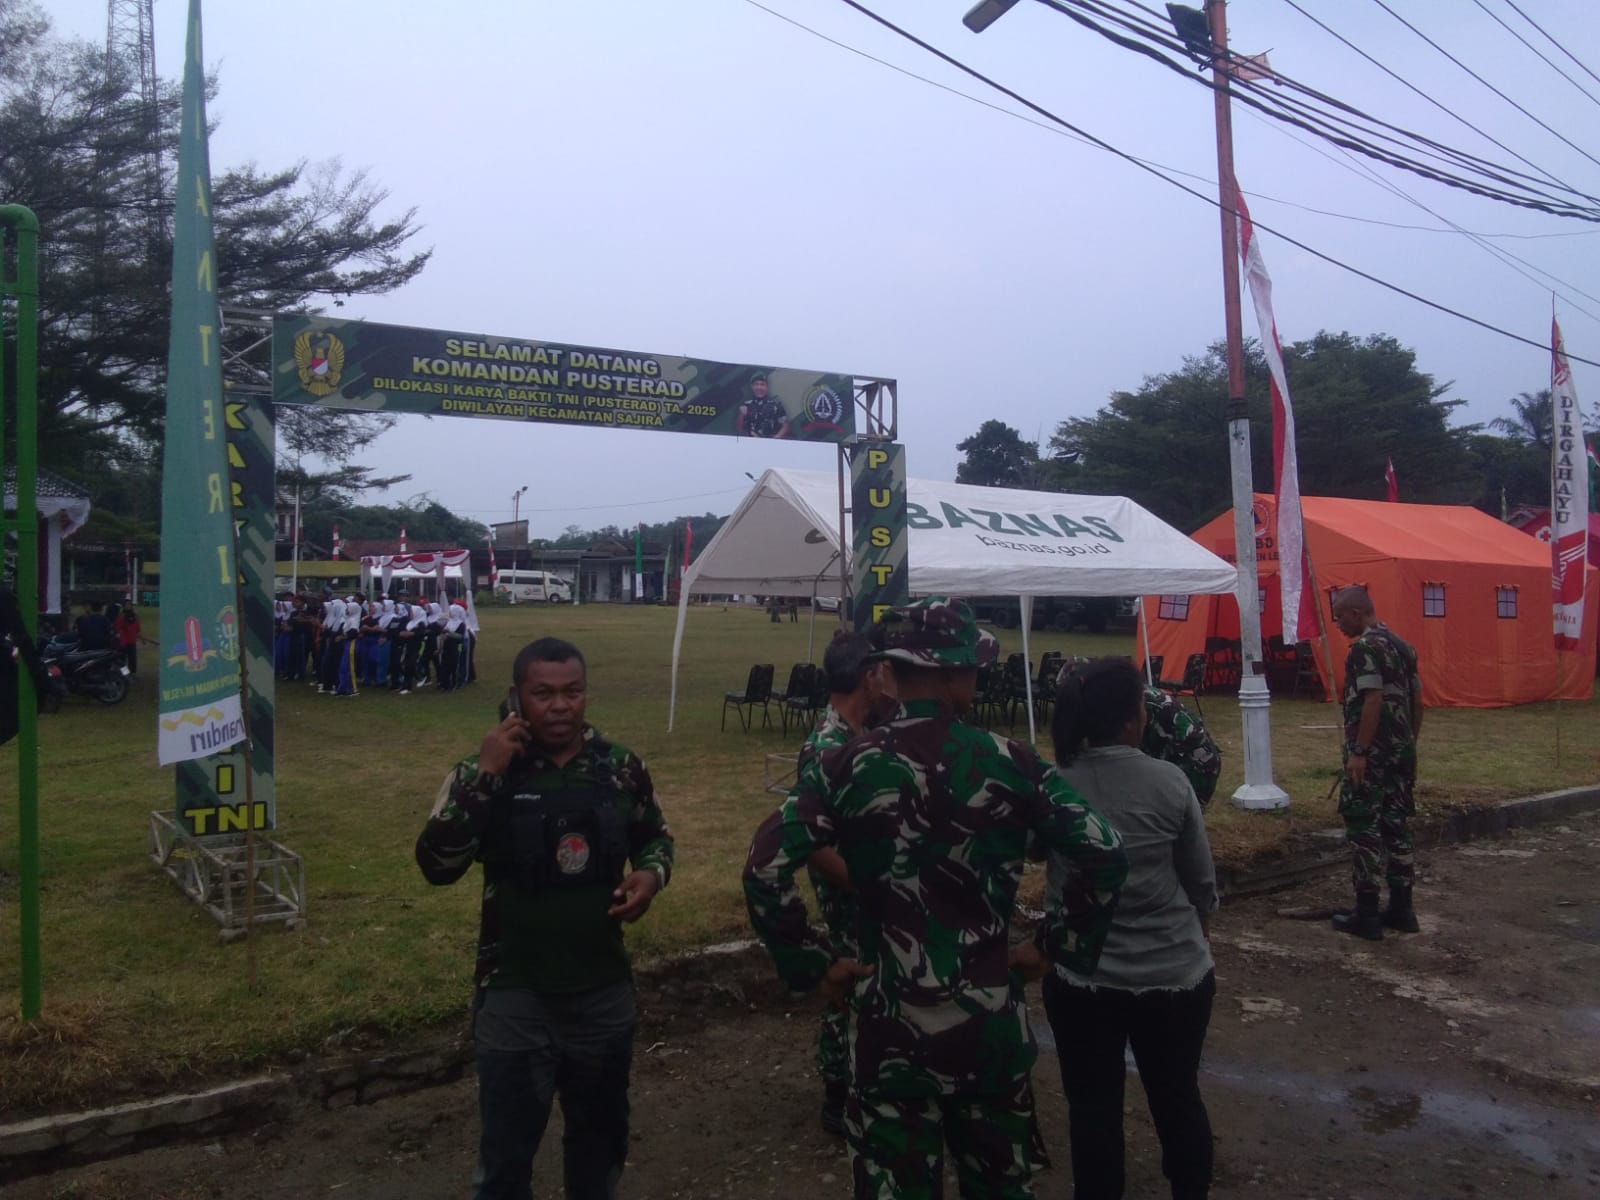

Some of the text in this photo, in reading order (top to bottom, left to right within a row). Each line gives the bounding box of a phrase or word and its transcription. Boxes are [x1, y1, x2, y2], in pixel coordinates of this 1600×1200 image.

[446, 338, 658, 375] SELAMAT DATANG
[373, 376, 717, 416] DILOKASI KARYA BAKTI TNI (PUSTERAD) TA. 2025
[412, 356, 684, 398] KOMANDAN PUSTERAD
[443, 399, 663, 426] DIWILAYAH KECAMATAN SAJIRA
[1556, 395, 1575, 524] DIRGAHAYU
[906, 501, 1124, 543] BAZNAS
[976, 534, 1112, 557] baznas.go.id
[184, 801, 266, 835] TNI
